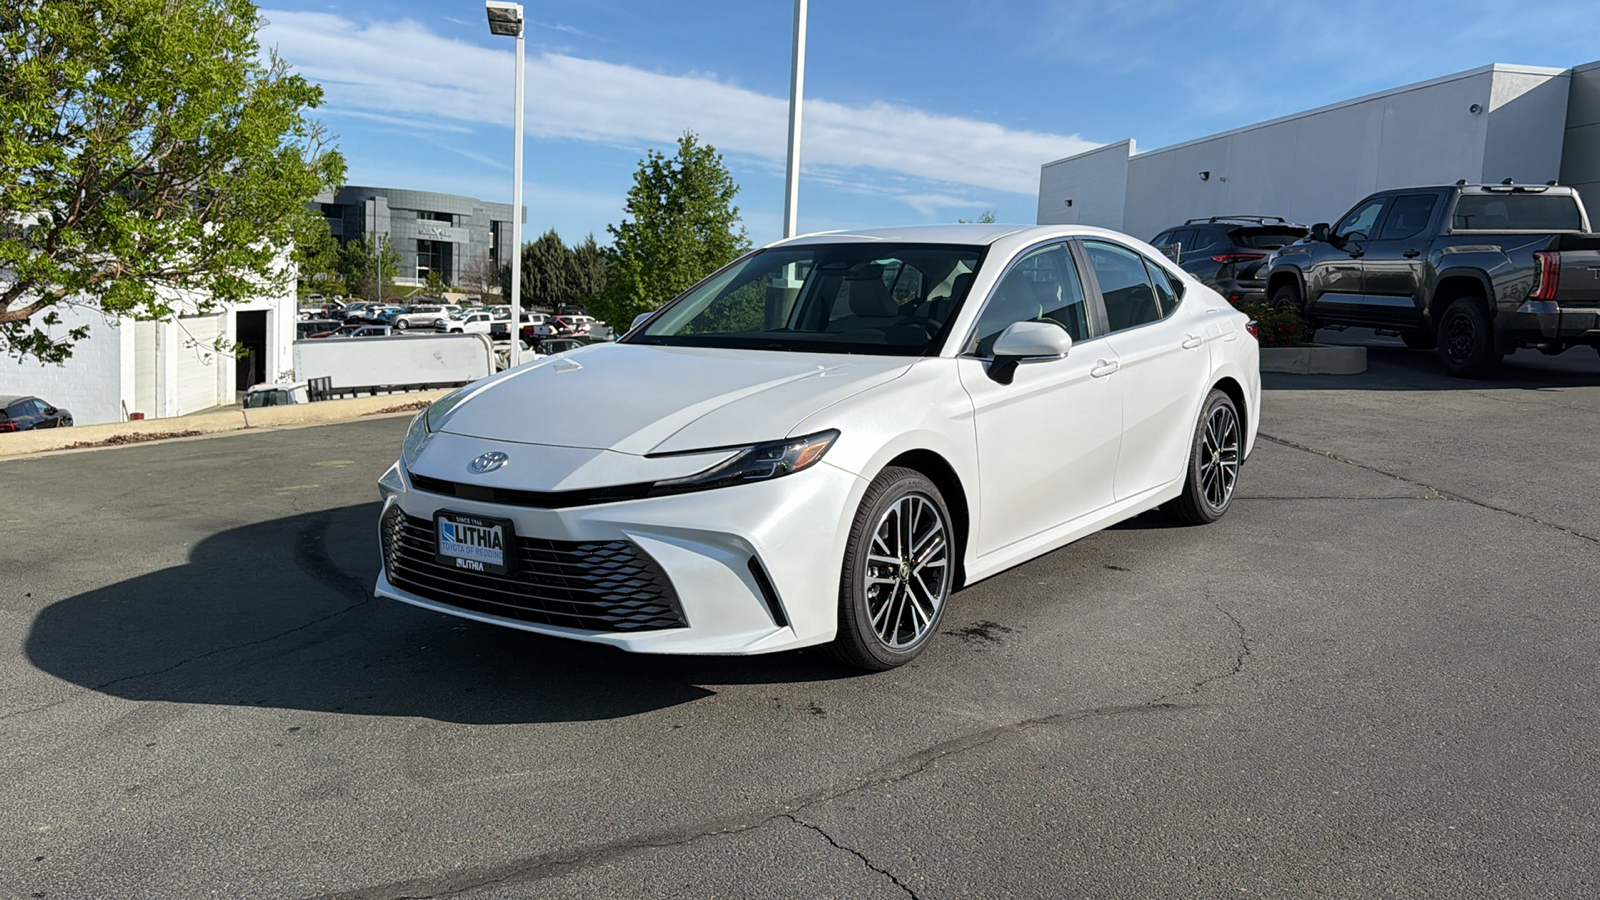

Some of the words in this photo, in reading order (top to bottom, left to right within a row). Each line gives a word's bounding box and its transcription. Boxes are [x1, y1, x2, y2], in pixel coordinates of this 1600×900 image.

[455, 525, 502, 550] LITHIA
[442, 542, 465, 553] TOYOTA
[466, 546, 475, 554] OF
[475, 548, 503, 560] REDDING
[462, 559, 484, 572] LITHIA
